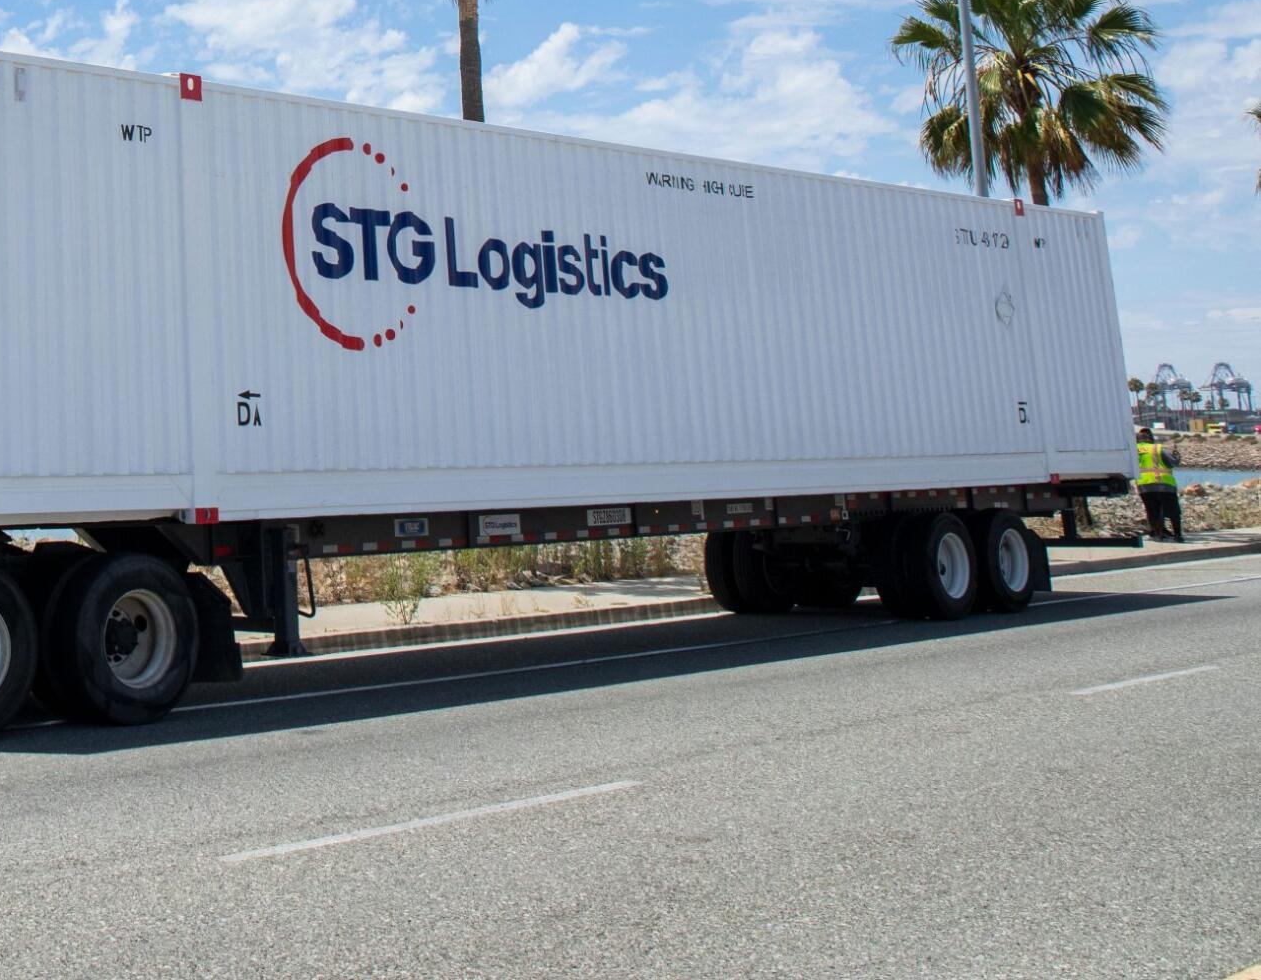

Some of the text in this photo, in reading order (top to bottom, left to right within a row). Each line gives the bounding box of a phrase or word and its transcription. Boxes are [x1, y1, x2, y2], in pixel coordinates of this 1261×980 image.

[120, 123, 153, 143] WTP
[311, 202, 669, 309] STG Logistics
